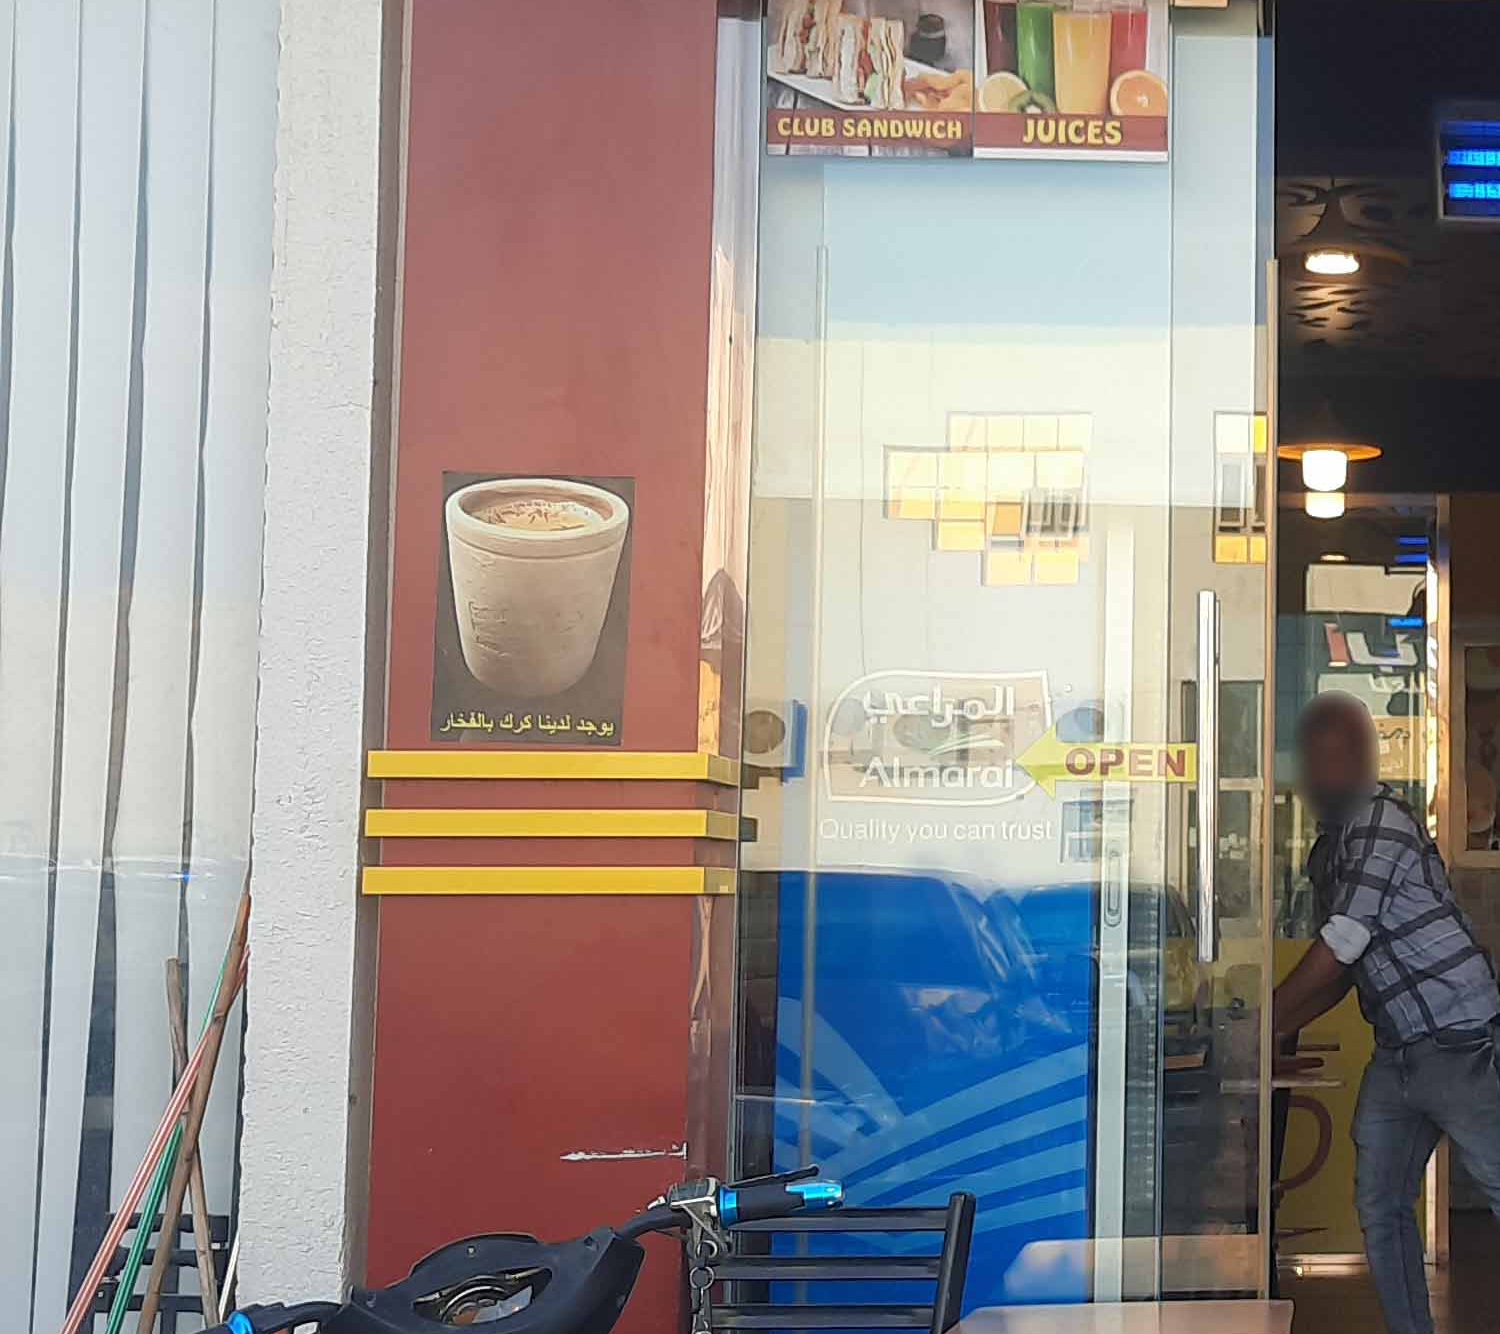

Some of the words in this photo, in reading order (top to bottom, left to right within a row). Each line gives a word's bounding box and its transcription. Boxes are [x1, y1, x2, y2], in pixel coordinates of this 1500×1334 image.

[776, 117, 835, 137] CLUB
[842, 117, 963, 141] SANDWICH
[1022, 119, 1123, 146] JUICES
[862, 685, 1015, 728] المراعي
[499, 712, 532, 734] كرك
[858, 755, 1014, 789] Almarai
[1064, 746, 1187, 777] OPEN
[905, 823, 948, 844] you
[953, 822, 996, 841] can
[1000, 820, 1053, 842] trust
